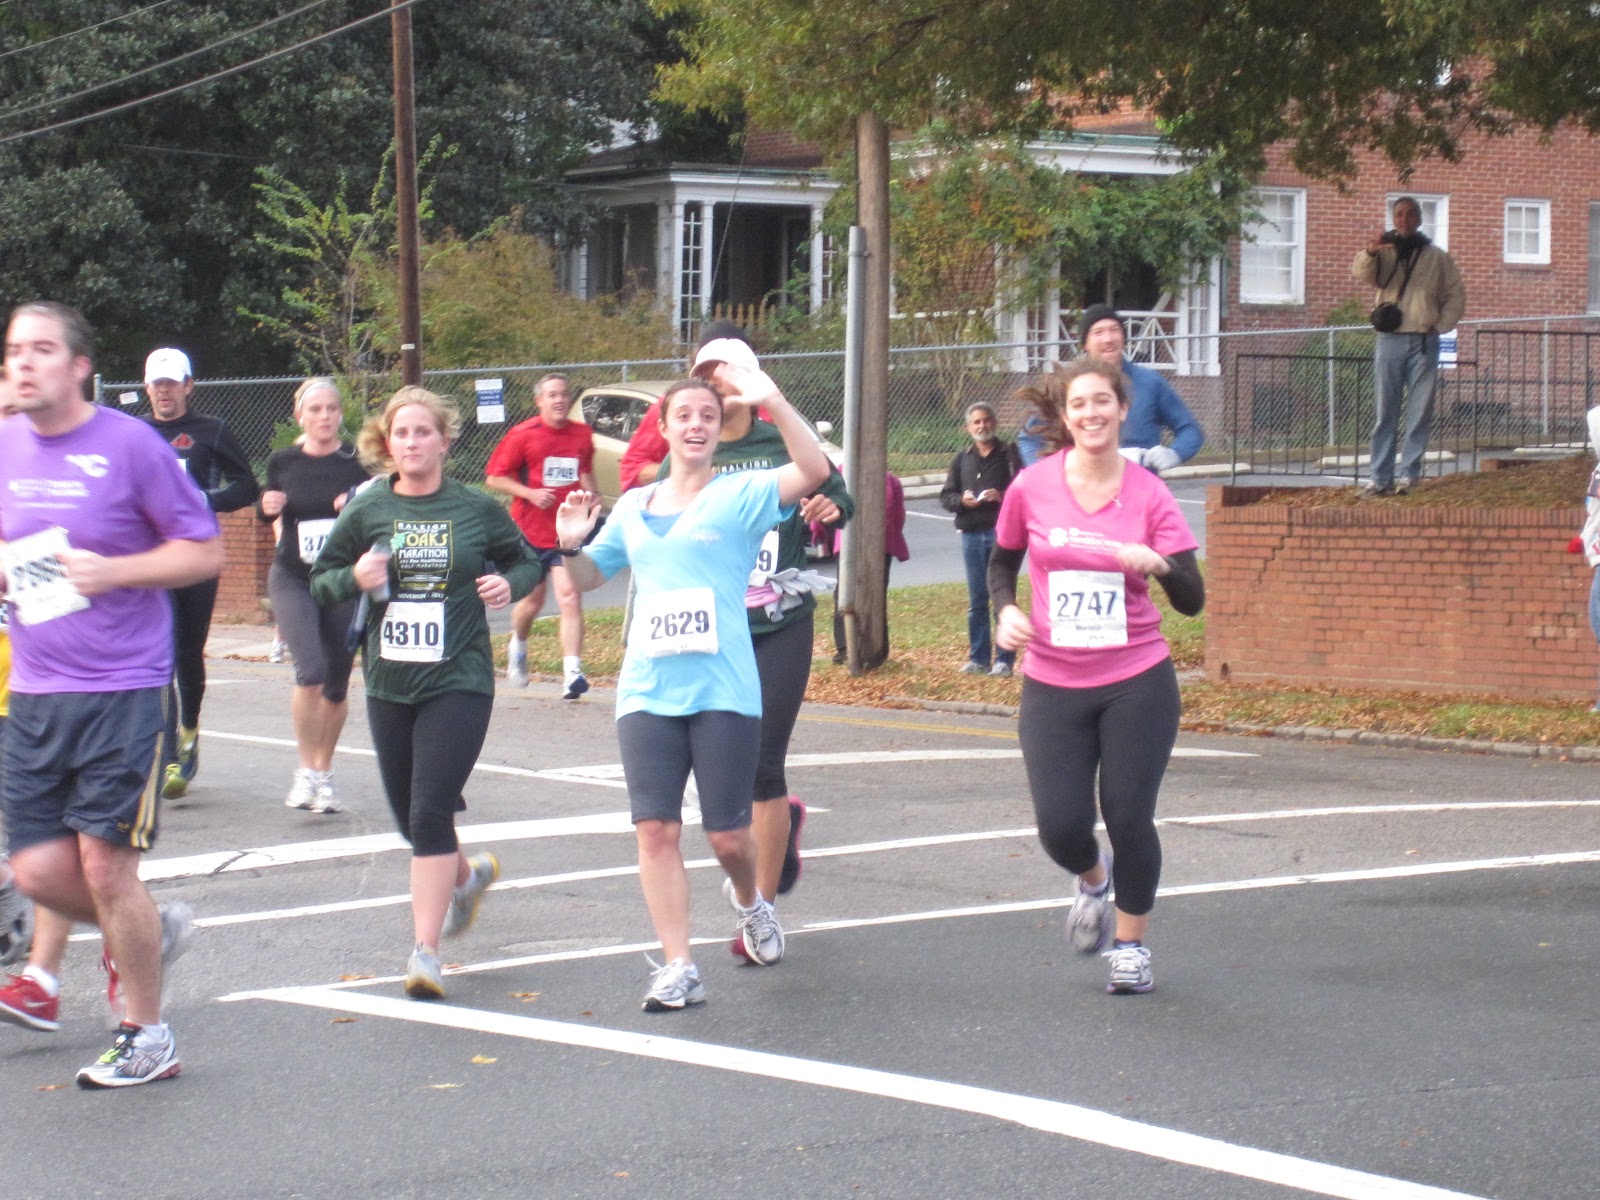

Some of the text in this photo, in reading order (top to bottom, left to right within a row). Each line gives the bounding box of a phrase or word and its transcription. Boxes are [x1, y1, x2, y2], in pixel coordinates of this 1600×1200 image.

[720, 459, 768, 473] RALEIGH
[397, 522, 447, 530] RALEIGH
[406, 533, 448, 547] OAKS
[399, 549, 448, 559] MARATHON
[1056, 590, 1117, 617] 2747
[650, 609, 710, 641] 2629
[383, 620, 440, 647] 4310
